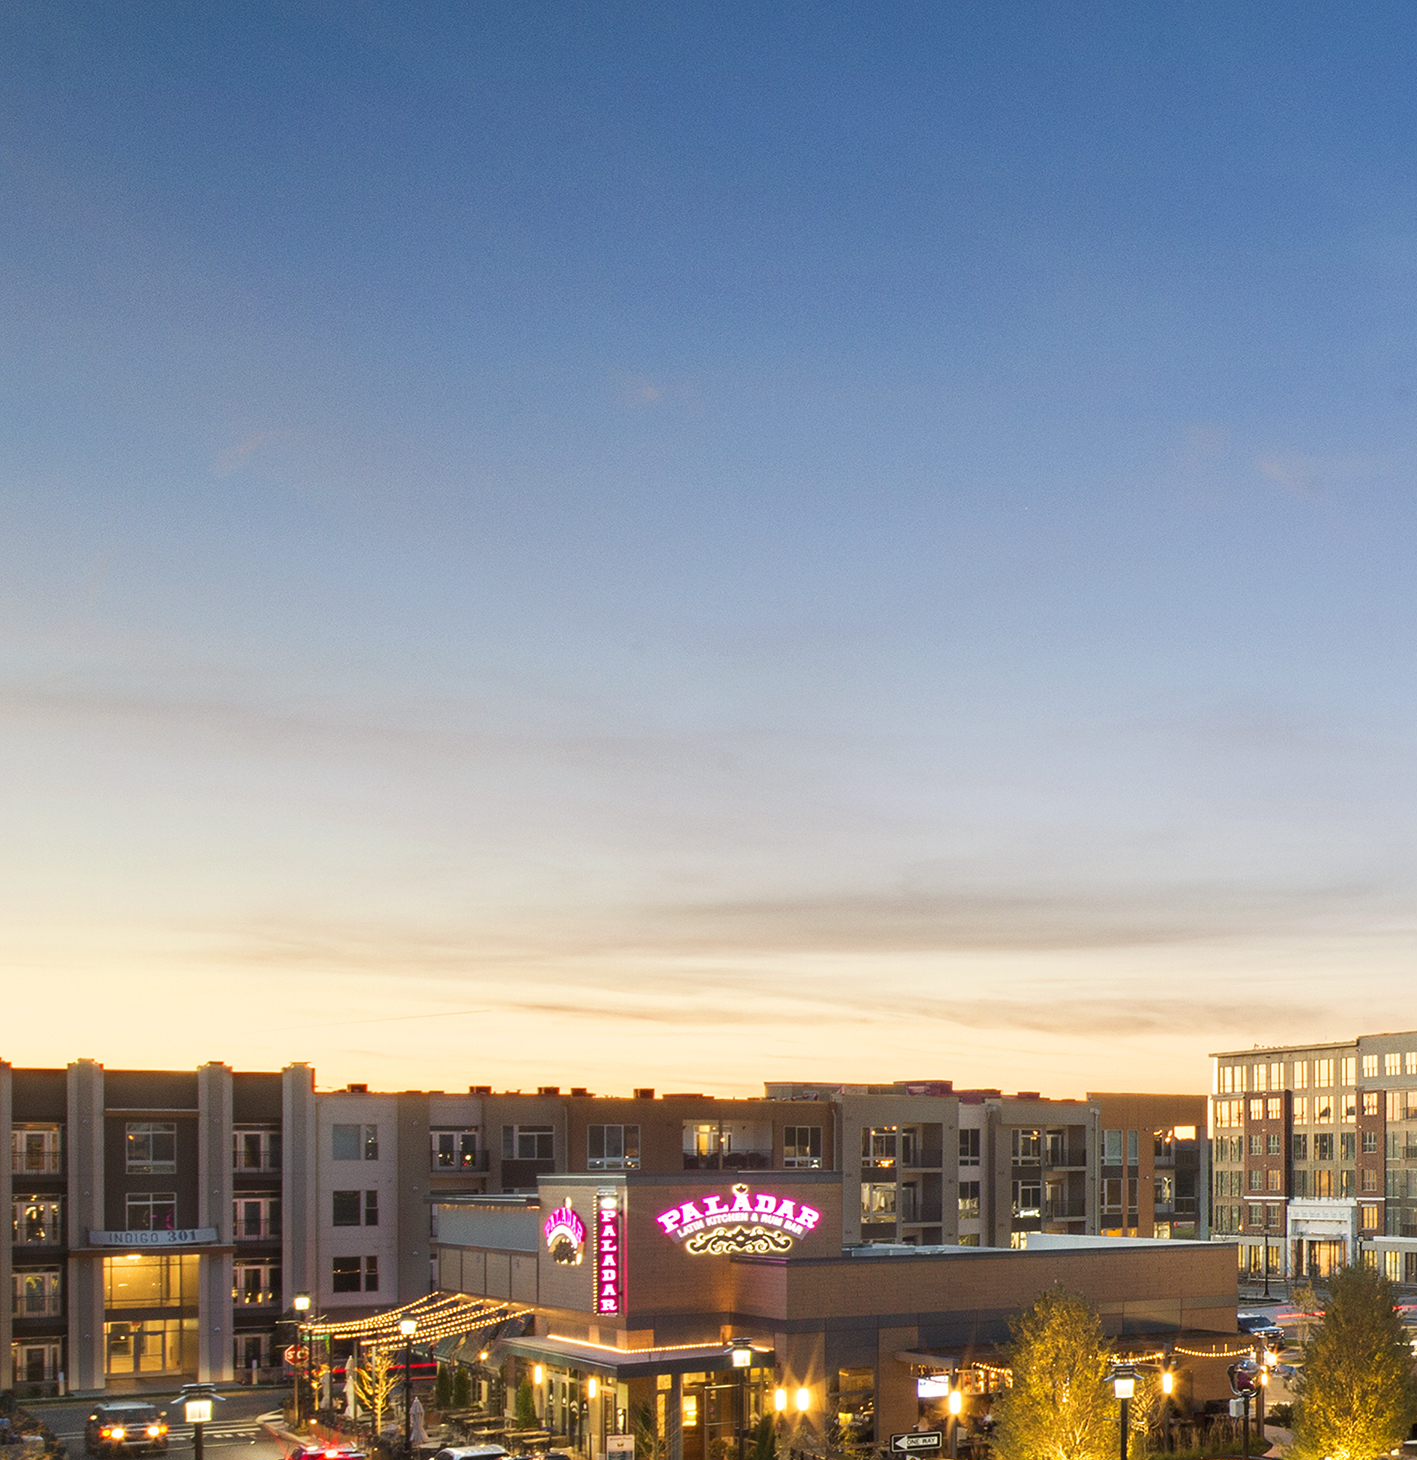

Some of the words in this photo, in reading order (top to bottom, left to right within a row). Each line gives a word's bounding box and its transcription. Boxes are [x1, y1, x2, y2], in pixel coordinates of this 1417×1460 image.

[657, 1193, 820, 1234] PALADAR
[677, 1220, 705, 1238] LATIN
[705, 1212, 749, 1226] KITCHEN
[750, 1212, 758, 1222] &
[760, 1214, 783, 1228] RUM
[783, 1221, 803, 1236] BAR
[109, 1232, 159, 1243] INDIGO
[167, 1230, 197, 1242] 301
[600, 1210, 617, 1312] PALADAR
